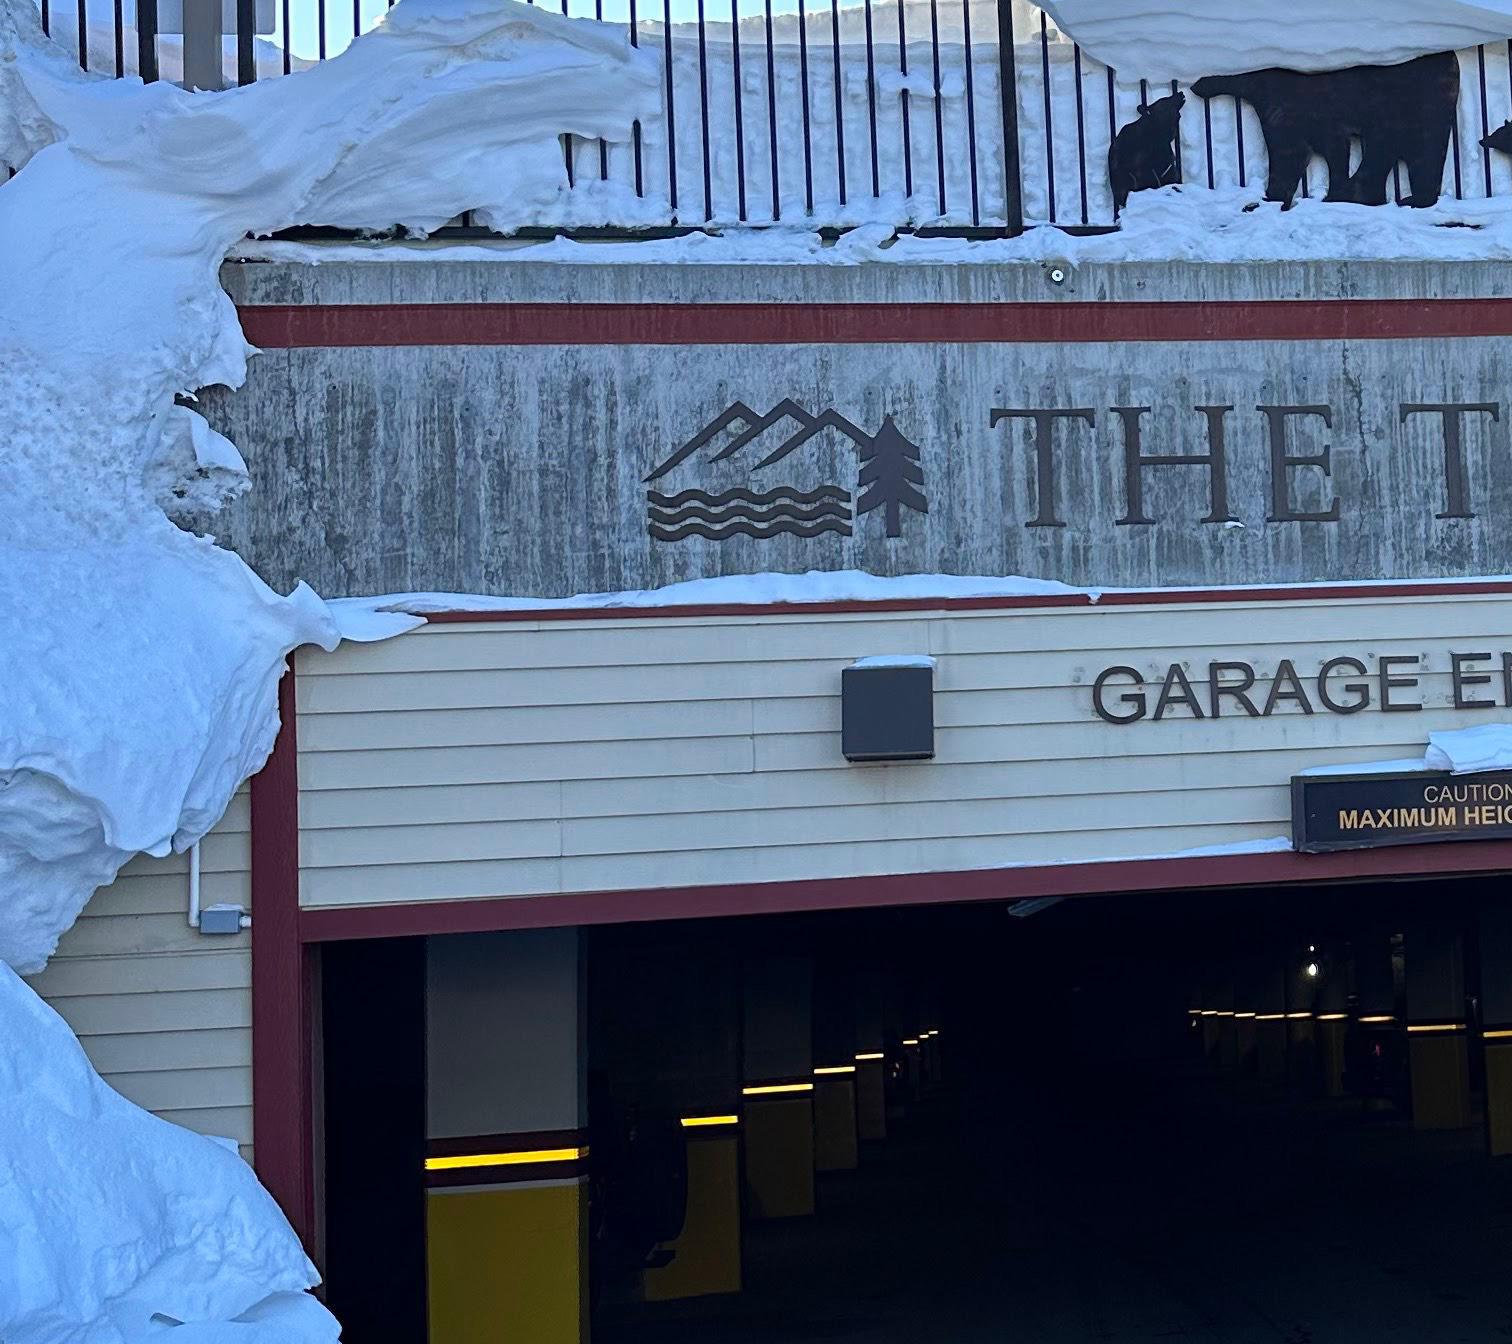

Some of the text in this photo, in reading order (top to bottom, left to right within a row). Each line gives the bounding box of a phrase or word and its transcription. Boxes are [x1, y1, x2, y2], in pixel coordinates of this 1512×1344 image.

[989, 404, 1341, 528] THE
[1092, 654, 1424, 725] GARAGE
[1338, 806, 1457, 830] MAXIMUM
